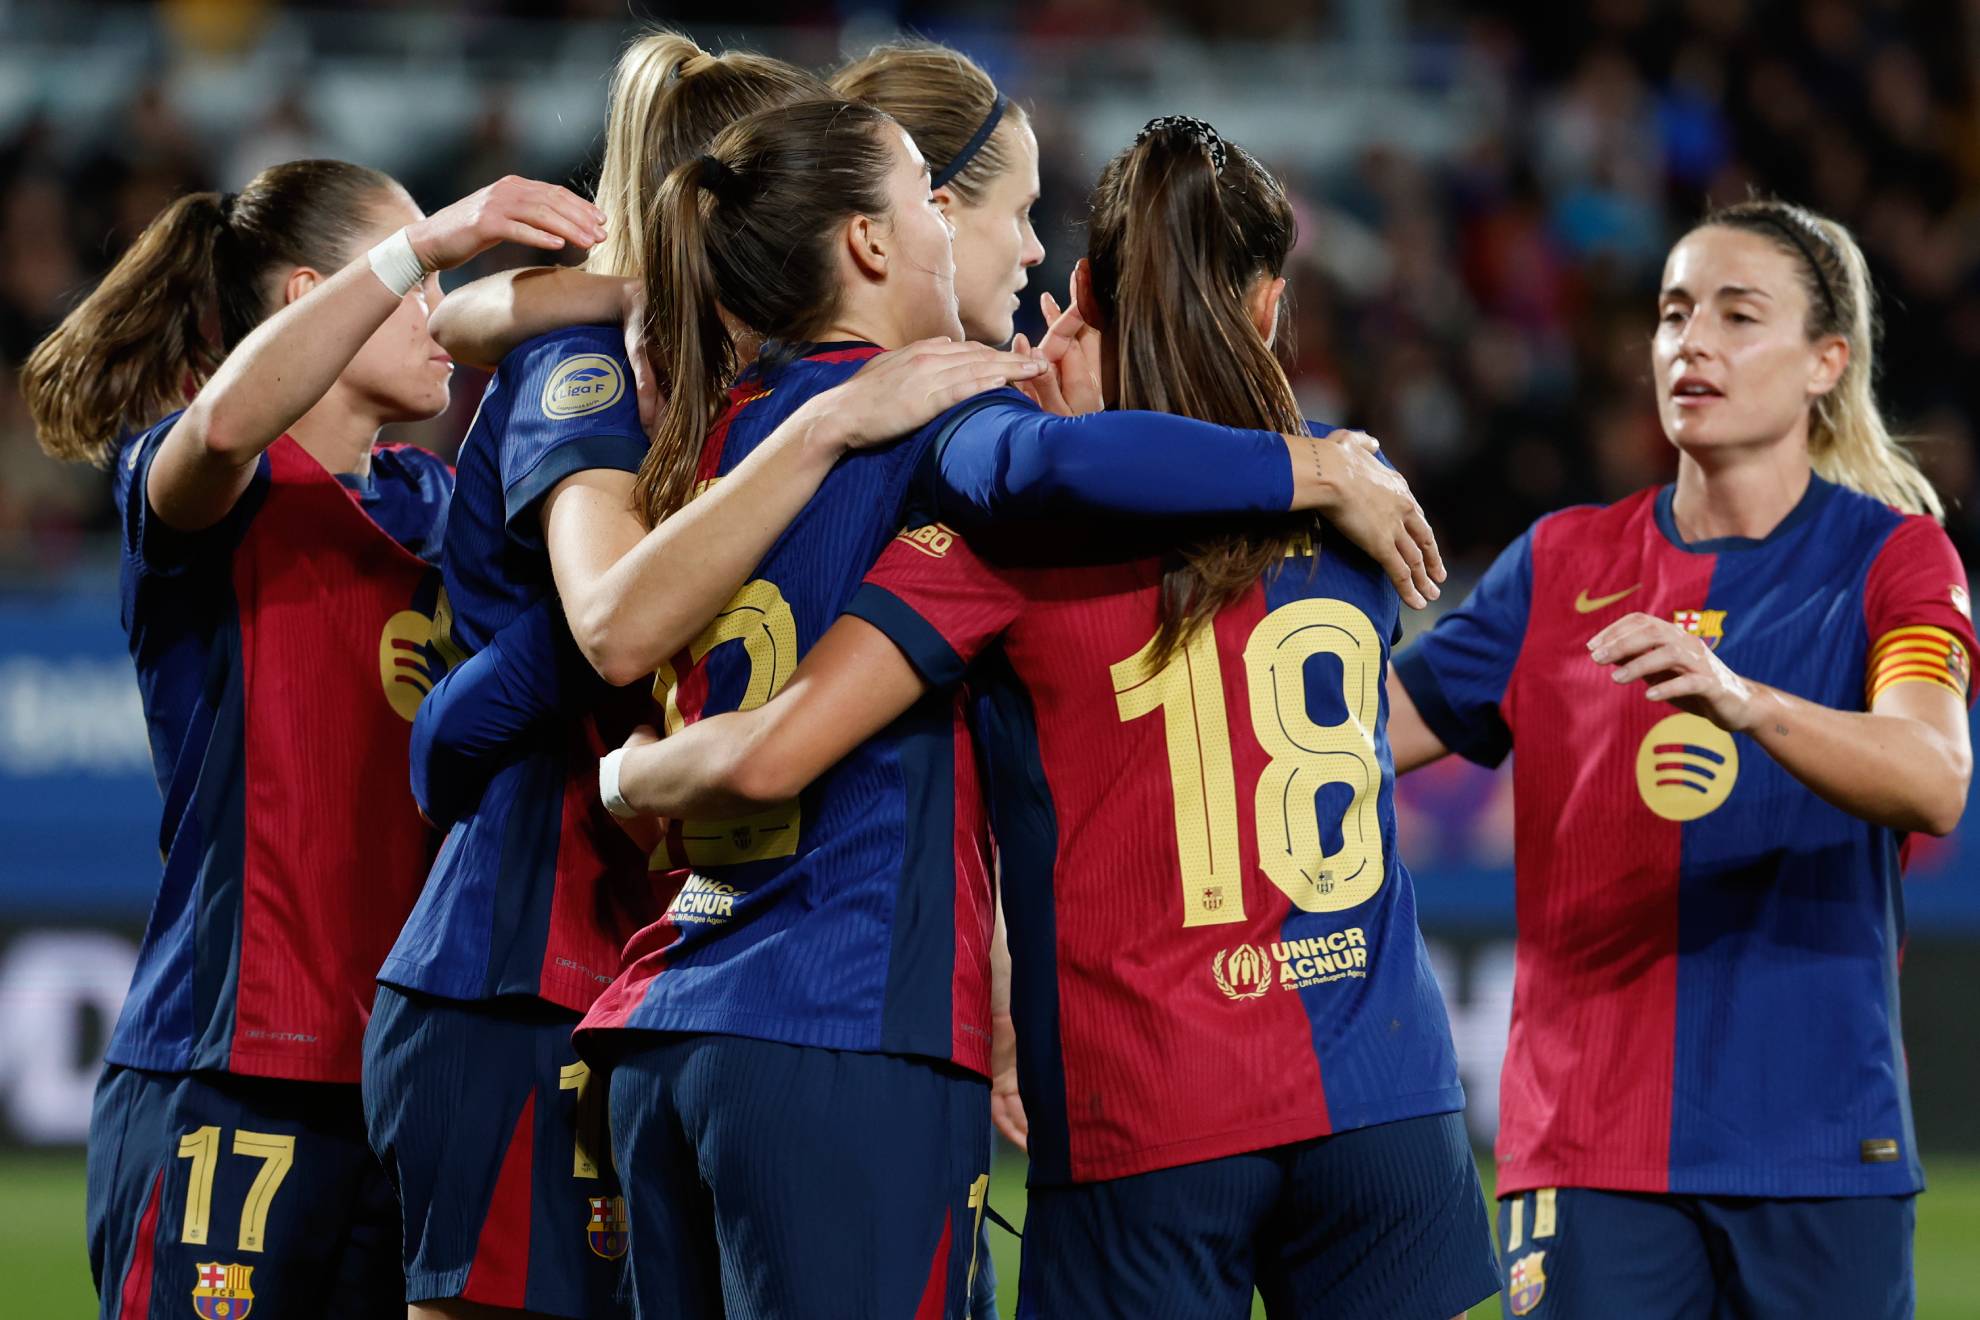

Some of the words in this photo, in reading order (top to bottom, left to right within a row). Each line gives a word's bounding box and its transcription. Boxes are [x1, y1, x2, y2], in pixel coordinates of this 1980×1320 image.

[560, 385, 591, 398] Liga
[594, 384, 606, 393] F
[1109, 597, 1385, 929] 18
[668, 893, 734, 917] ACNUR
[1271, 927, 1367, 962] UNHCR
[1279, 947, 1368, 984] ACNUR
[1282, 983, 1299, 991] The
[1298, 979, 1313, 988] UN
[1312, 972, 1347, 985] Refugee
[178, 1125, 296, 1253] 17
[211, 1288, 236, 1298] FCB
